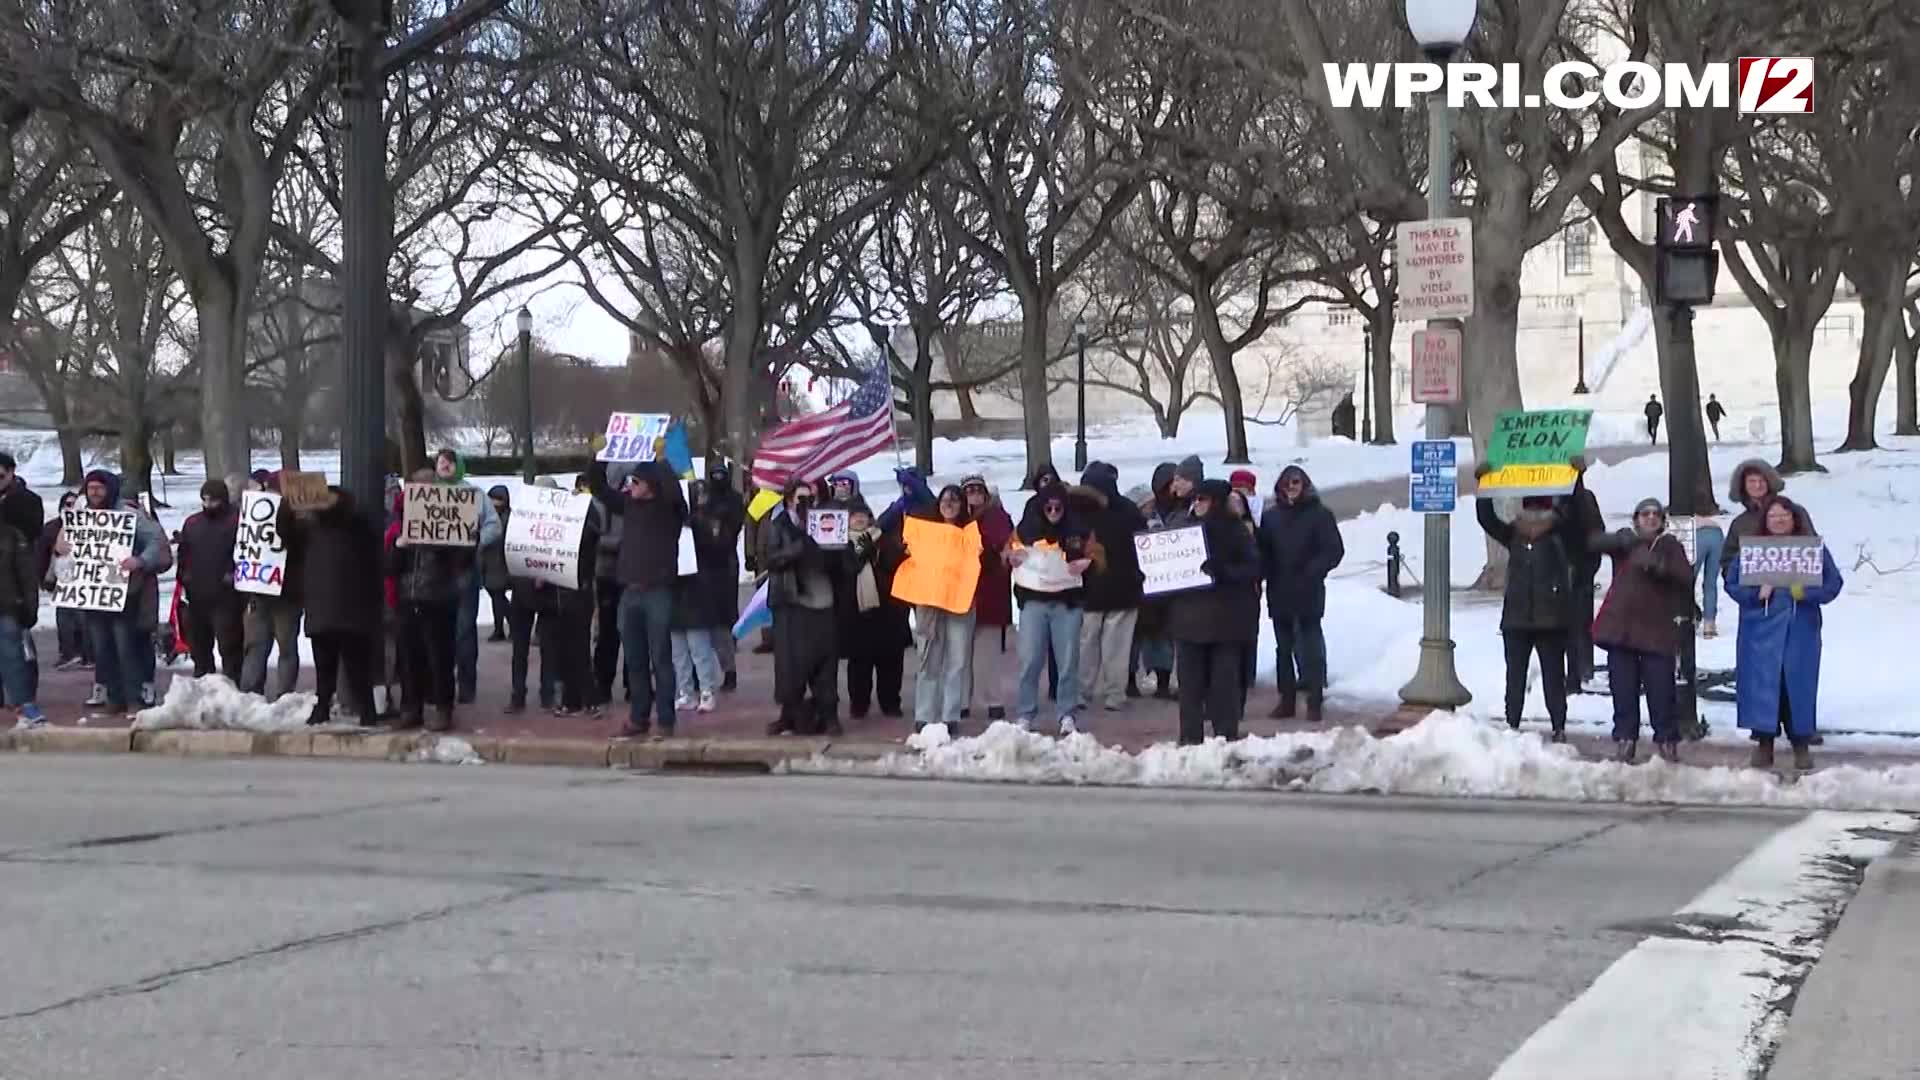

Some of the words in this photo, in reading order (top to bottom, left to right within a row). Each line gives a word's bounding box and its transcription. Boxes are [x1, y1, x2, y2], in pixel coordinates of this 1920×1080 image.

[1433, 227, 1459, 239] AREA
[1416, 241, 1440, 252] MAY
[1443, 240, 1456, 252] BE
[1407, 253, 1464, 266] MONITORED
[1429, 269, 1440, 280] BY
[1421, 282, 1452, 293] VIDEO
[1425, 335, 1447, 351] NO
[1501, 412, 1590, 432] IMPEACH
[605, 435, 655, 459] ELON
[1506, 431, 1571, 449] ELON
[409, 487, 413, 502] I
[415, 487, 442, 502] AM
[447, 487, 480, 504] NOT
[424, 504, 461, 520] YOUR
[64, 511, 134, 530] REMOVE
[408, 520, 475, 542] ENEMY
[73, 543, 113, 561] JAIL
[239, 546, 261, 560] IN
[1741, 547, 1823, 561] PROTECT
[72, 561, 105, 583] THE
[1741, 560, 1792, 574] TRANS
[51, 585, 123, 608] MASTER
